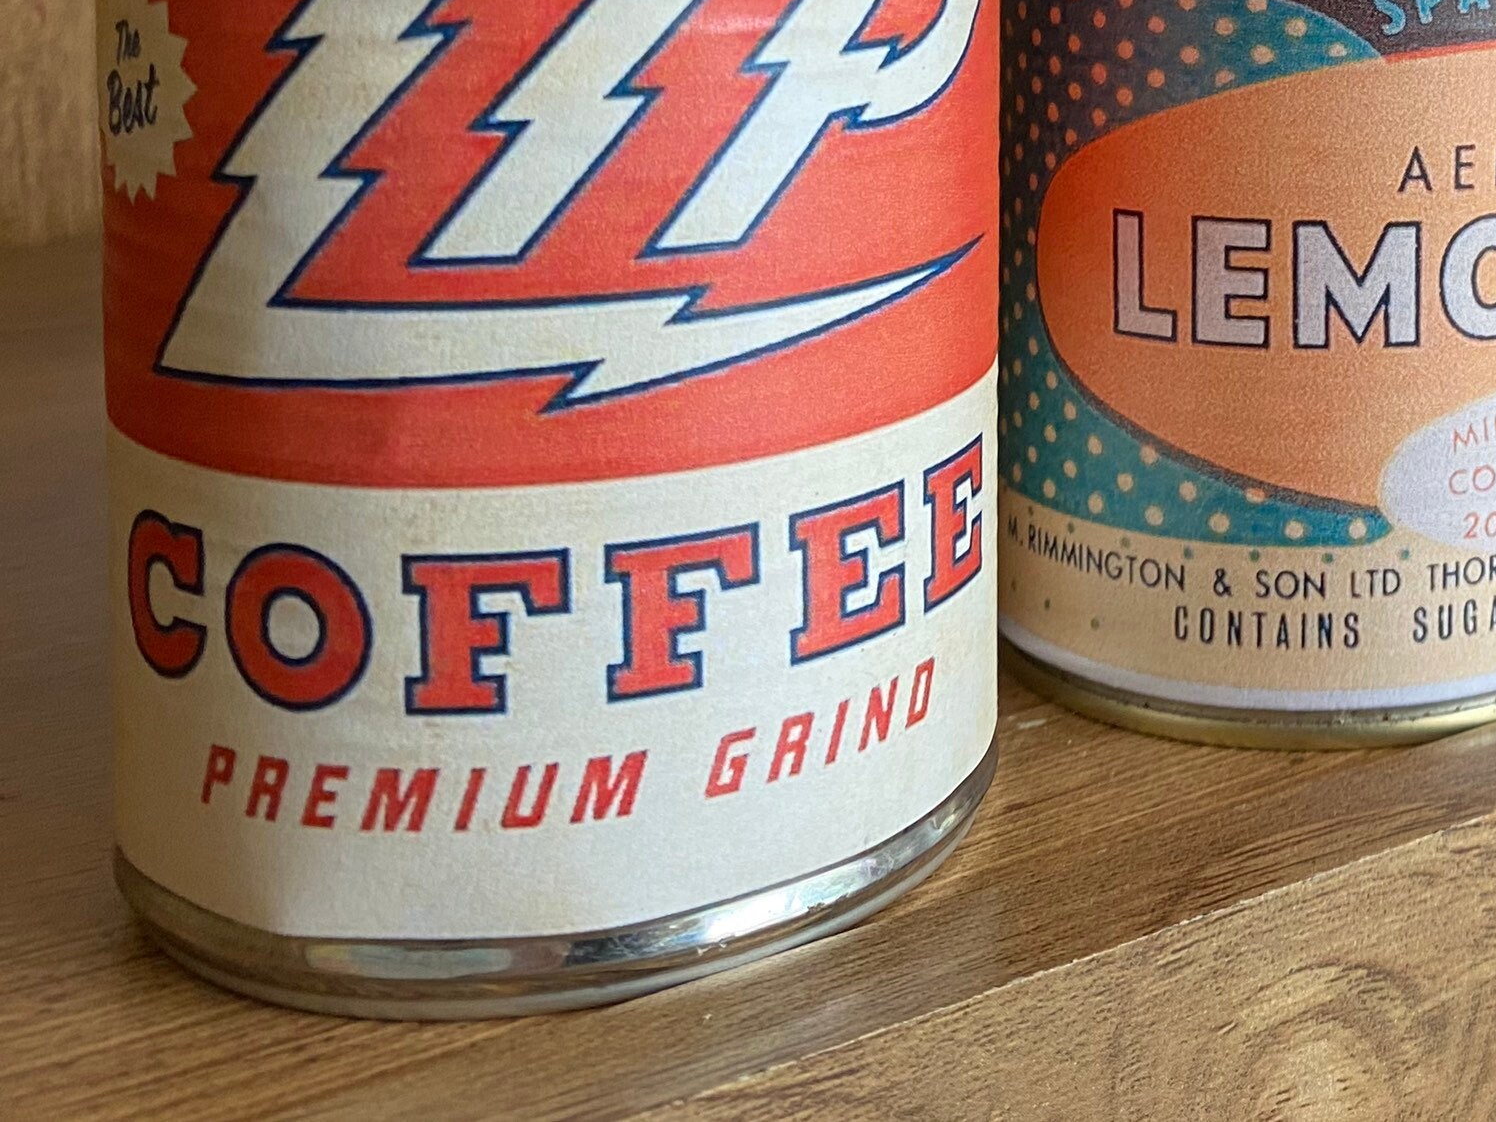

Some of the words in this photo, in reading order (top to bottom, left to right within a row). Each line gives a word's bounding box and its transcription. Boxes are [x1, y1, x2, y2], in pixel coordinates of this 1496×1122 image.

[115, 19, 142, 66] The
[106, 63, 159, 137] Best
[127, 434, 984, 716] COFFEE
[1028, 524, 1186, 591] RIMMINGTON
[1213, 569, 1233, 597] &
[1255, 571, 1326, 599] SON
[1351, 569, 1401, 599] LTD
[1174, 605, 1361, 649] CONTAINS
[202, 744, 649, 834] PREMIUM
[705, 657, 936, 800] GRIND
